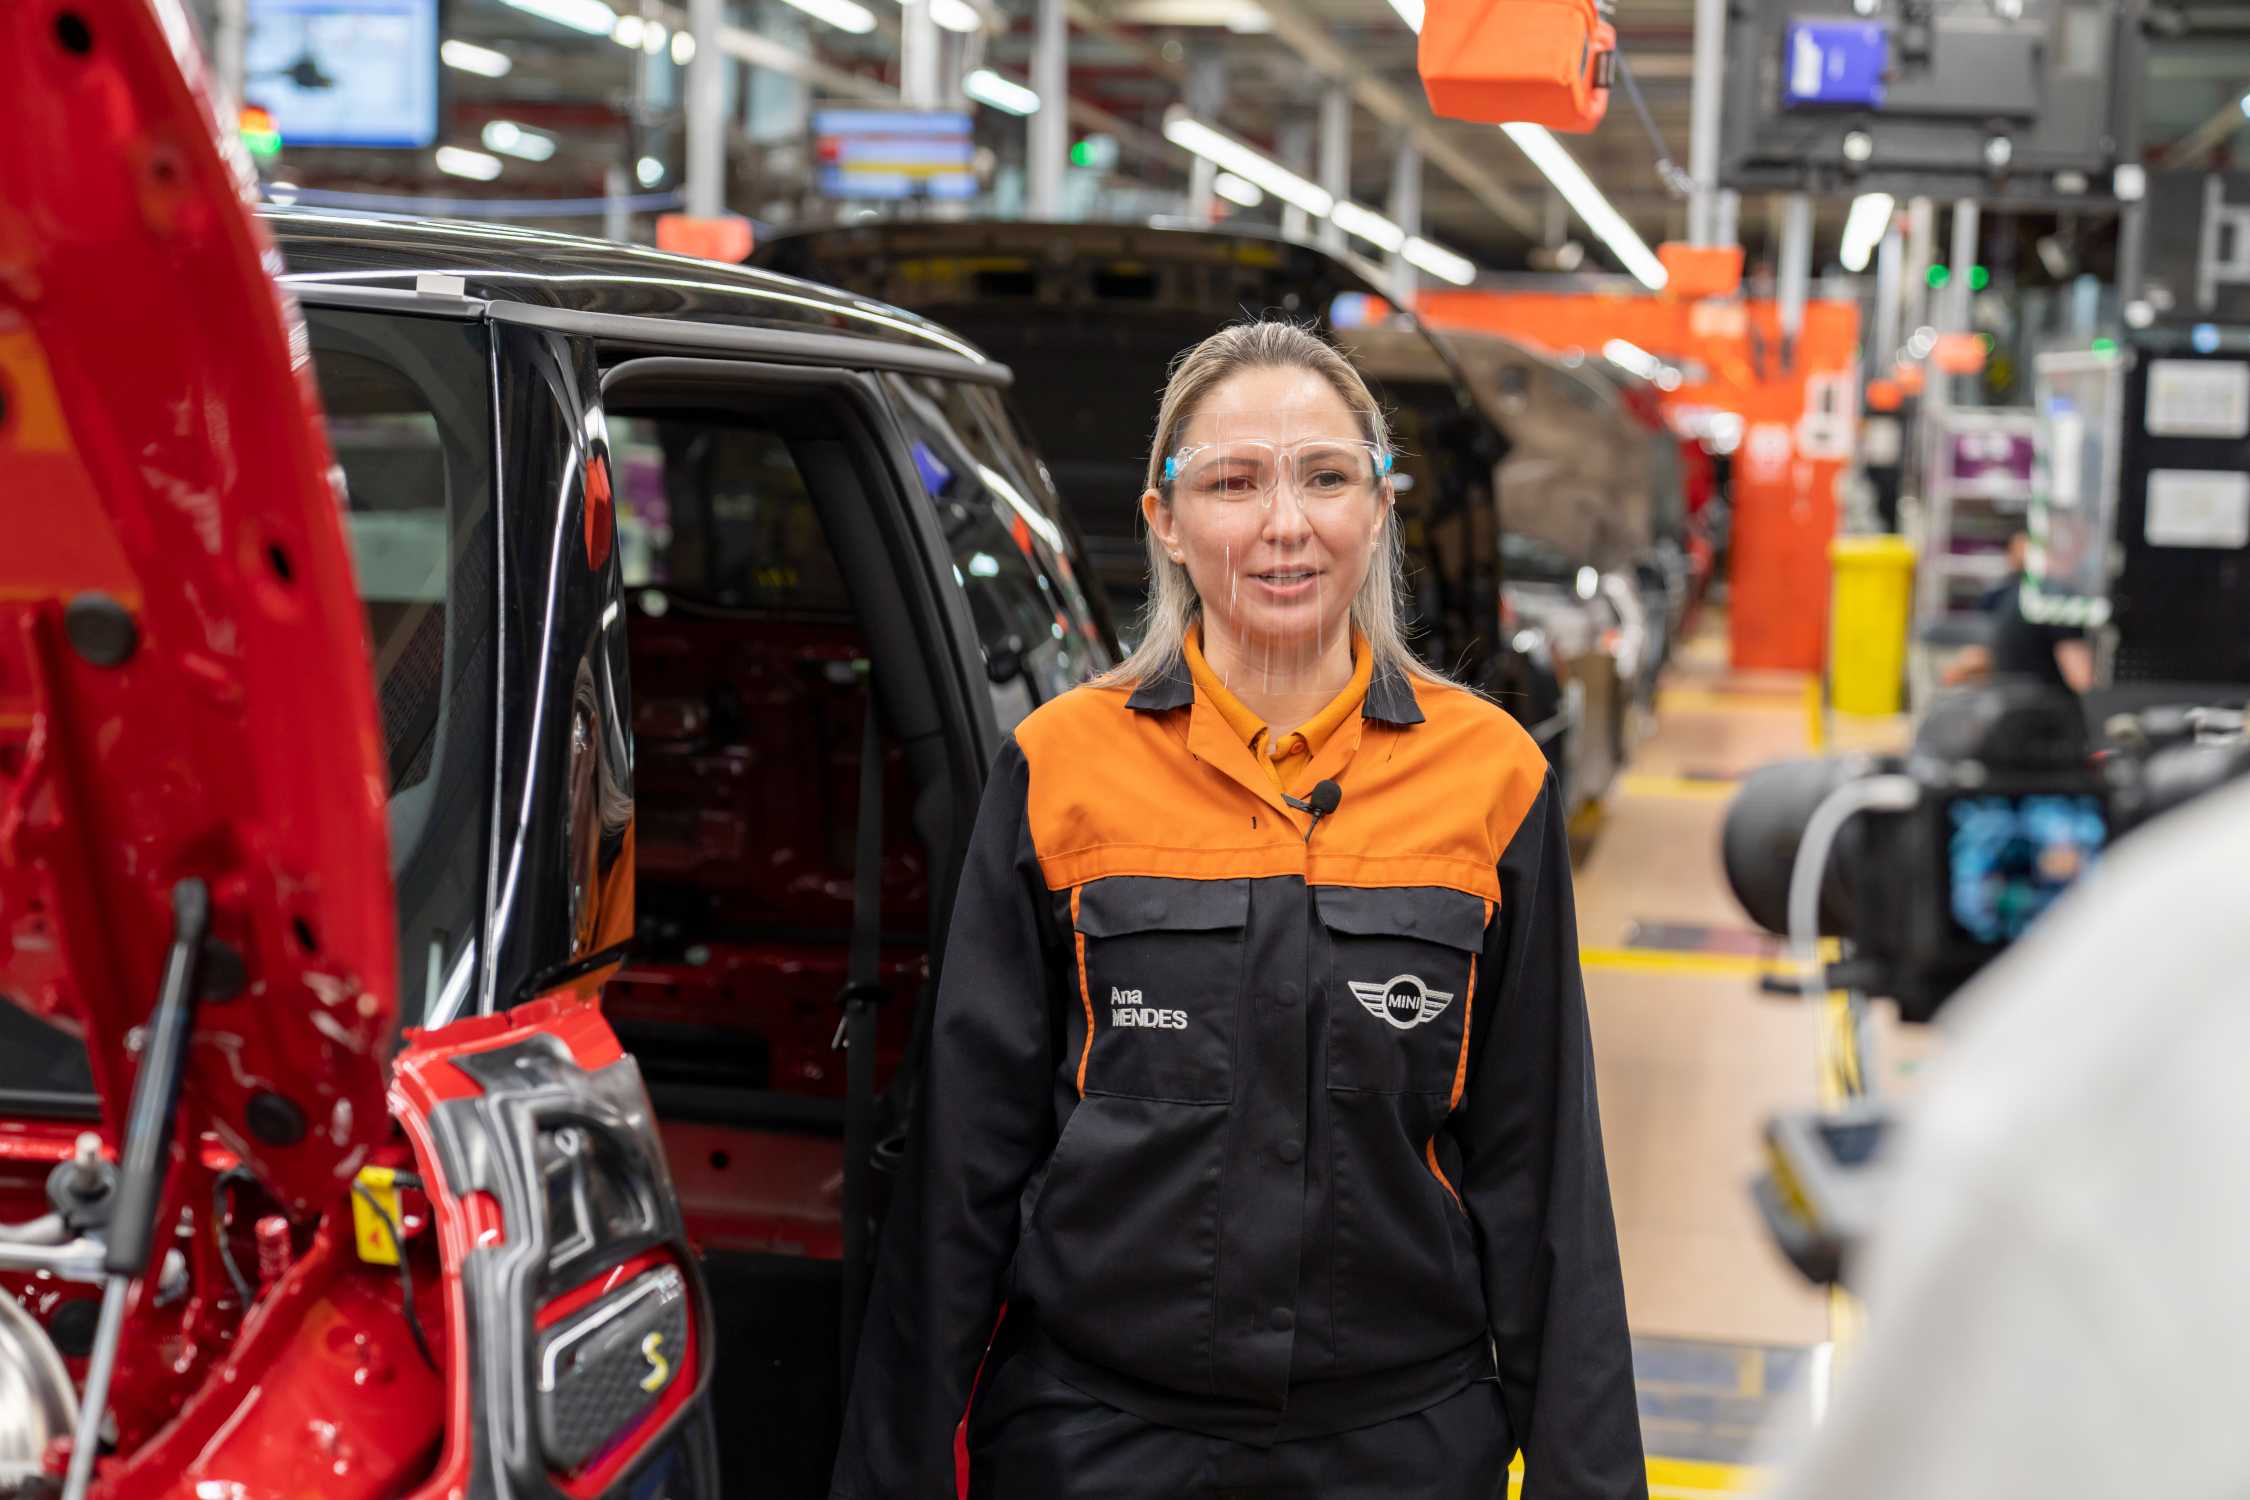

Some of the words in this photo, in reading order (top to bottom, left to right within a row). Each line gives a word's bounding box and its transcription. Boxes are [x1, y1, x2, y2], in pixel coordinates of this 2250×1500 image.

[1111, 986, 1143, 1005] Ana
[1388, 994, 1420, 1010] MINI
[1112, 1008, 1188, 1030] MENDES
